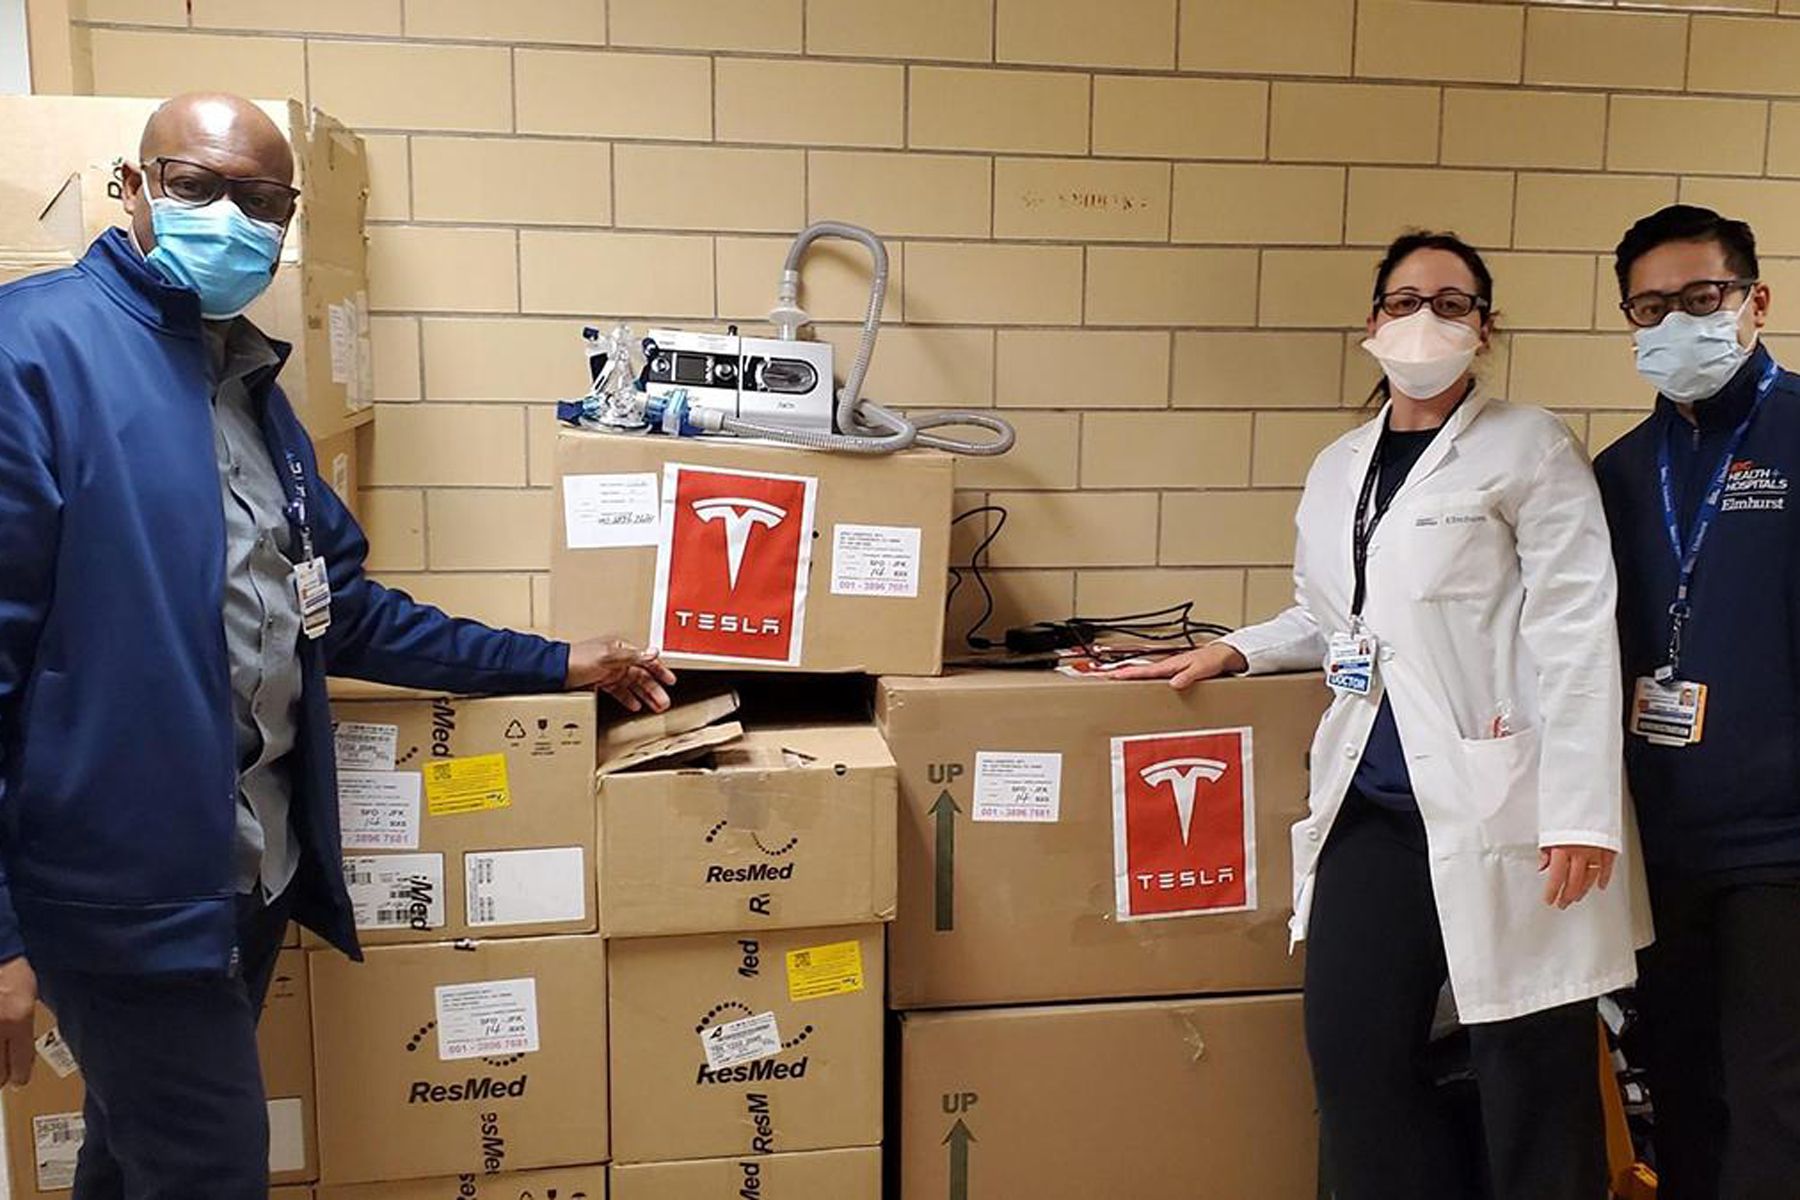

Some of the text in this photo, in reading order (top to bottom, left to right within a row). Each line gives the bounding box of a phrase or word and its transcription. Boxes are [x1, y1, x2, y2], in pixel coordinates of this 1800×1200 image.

[1724, 479, 1789, 492] HOSPITALS
[1721, 496, 1784, 512] Elmhurst
[675, 610, 782, 635] TESLA
[927, 763, 964, 784] UP
[706, 863, 794, 882] ResMed
[1137, 867, 1235, 890] TESLA
[411, 875, 432, 932] Med
[696, 1056, 809, 1085] ResMed
[408, 1075, 528, 1104] ResMed
[941, 1092, 979, 1114] UP
